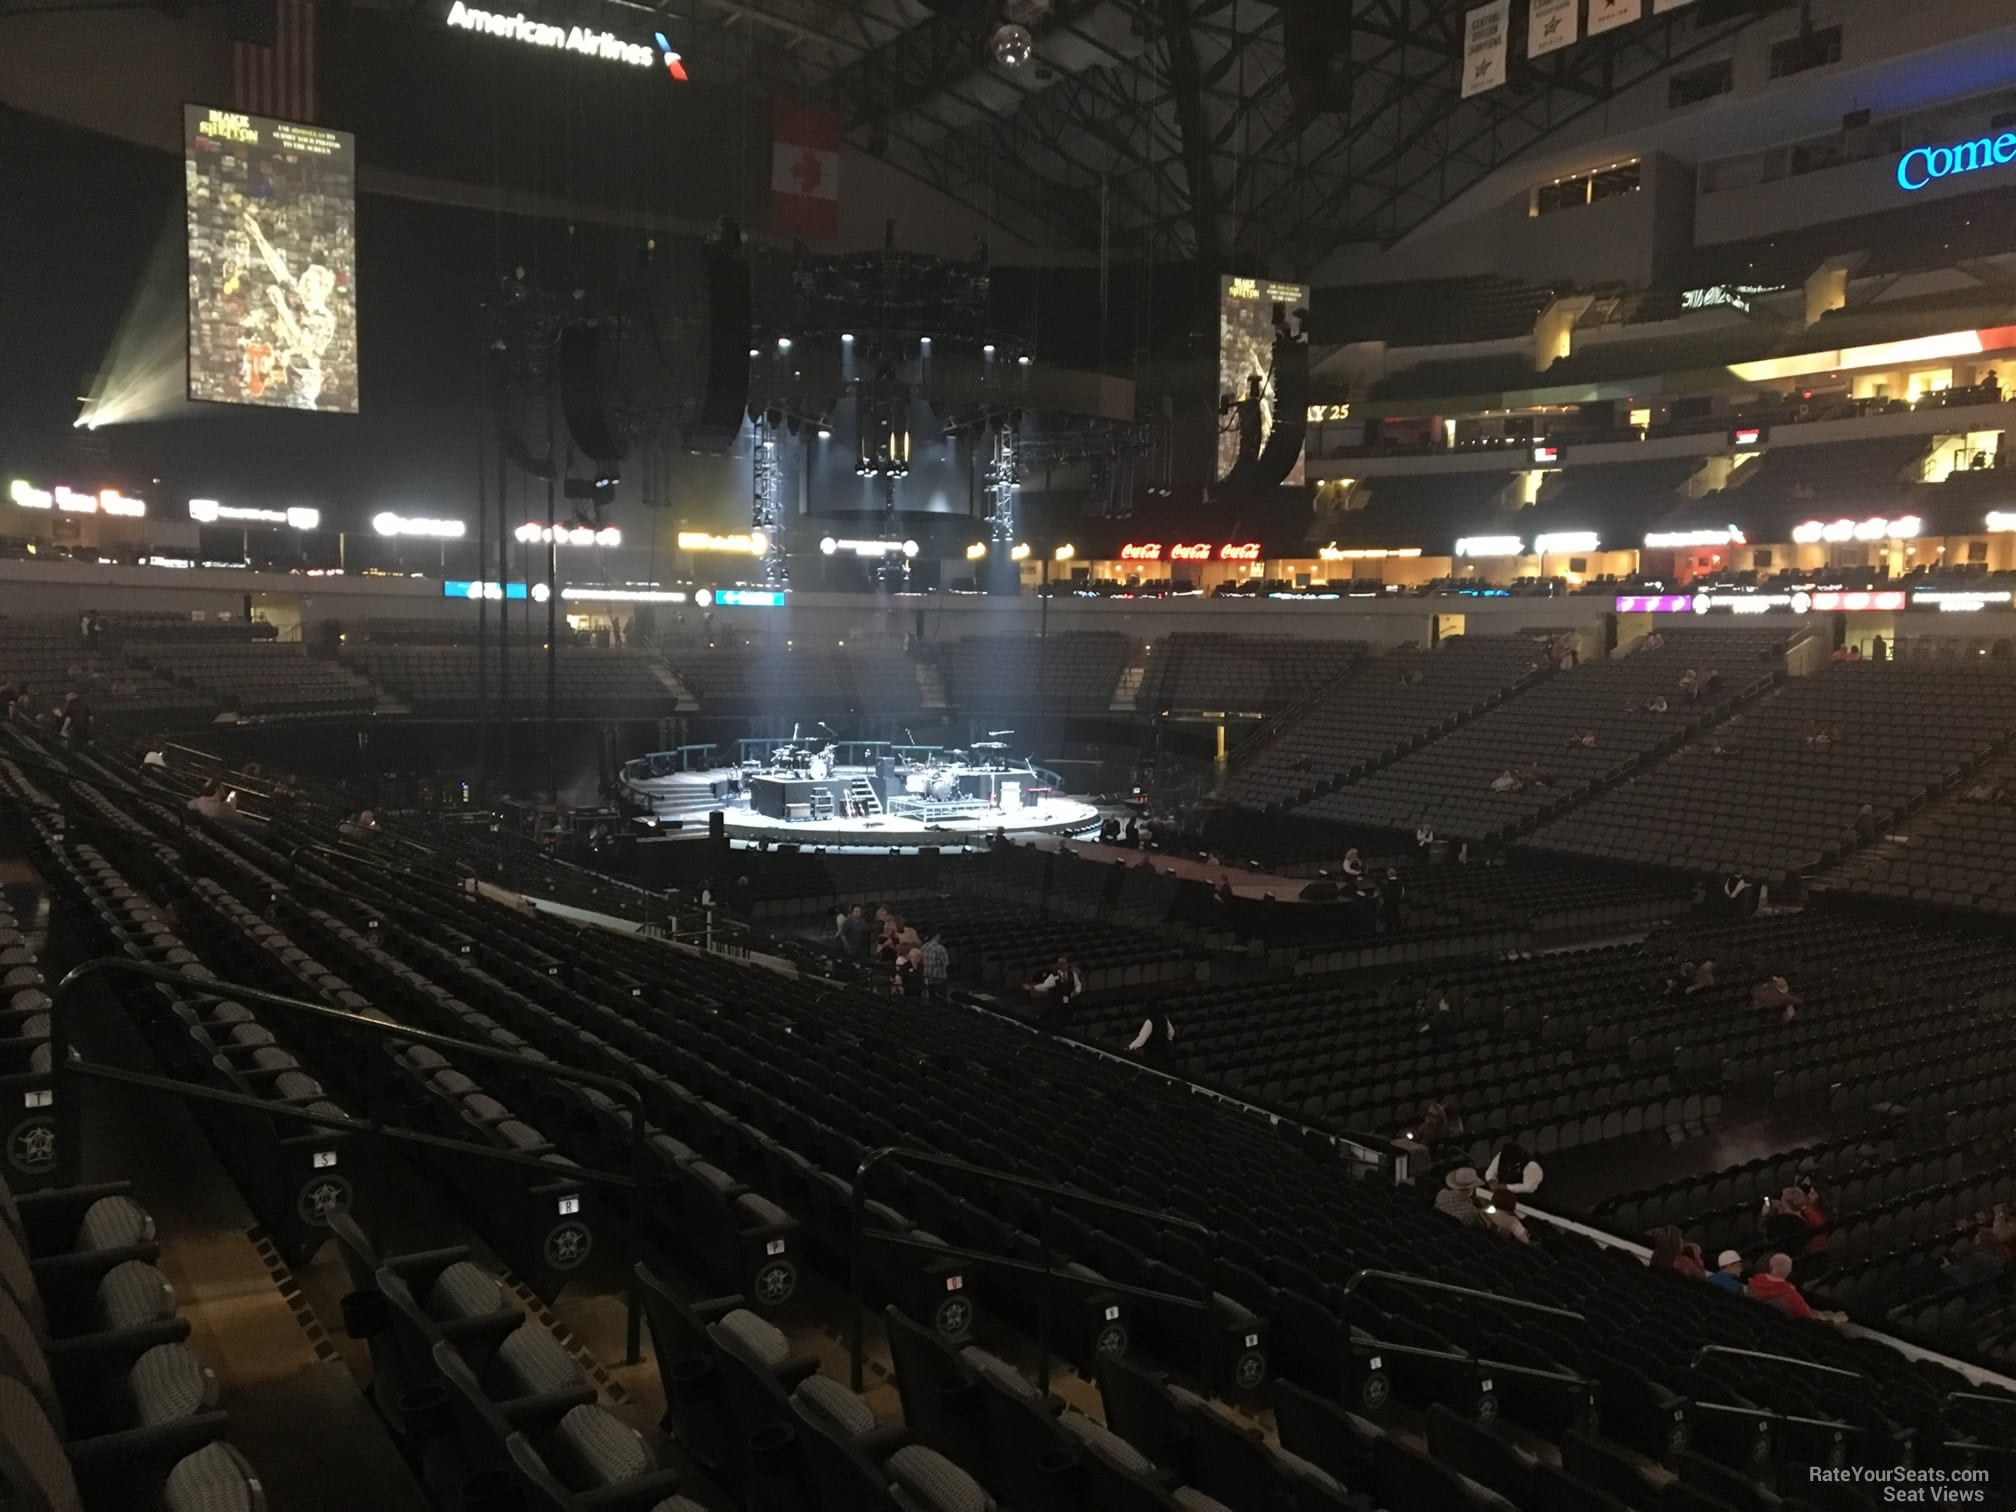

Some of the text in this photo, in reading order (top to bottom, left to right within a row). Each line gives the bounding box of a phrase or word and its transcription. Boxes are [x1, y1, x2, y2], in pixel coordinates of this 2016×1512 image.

[447, 1, 654, 67] American Airlines
[1330, 403, 1350, 420] 25
